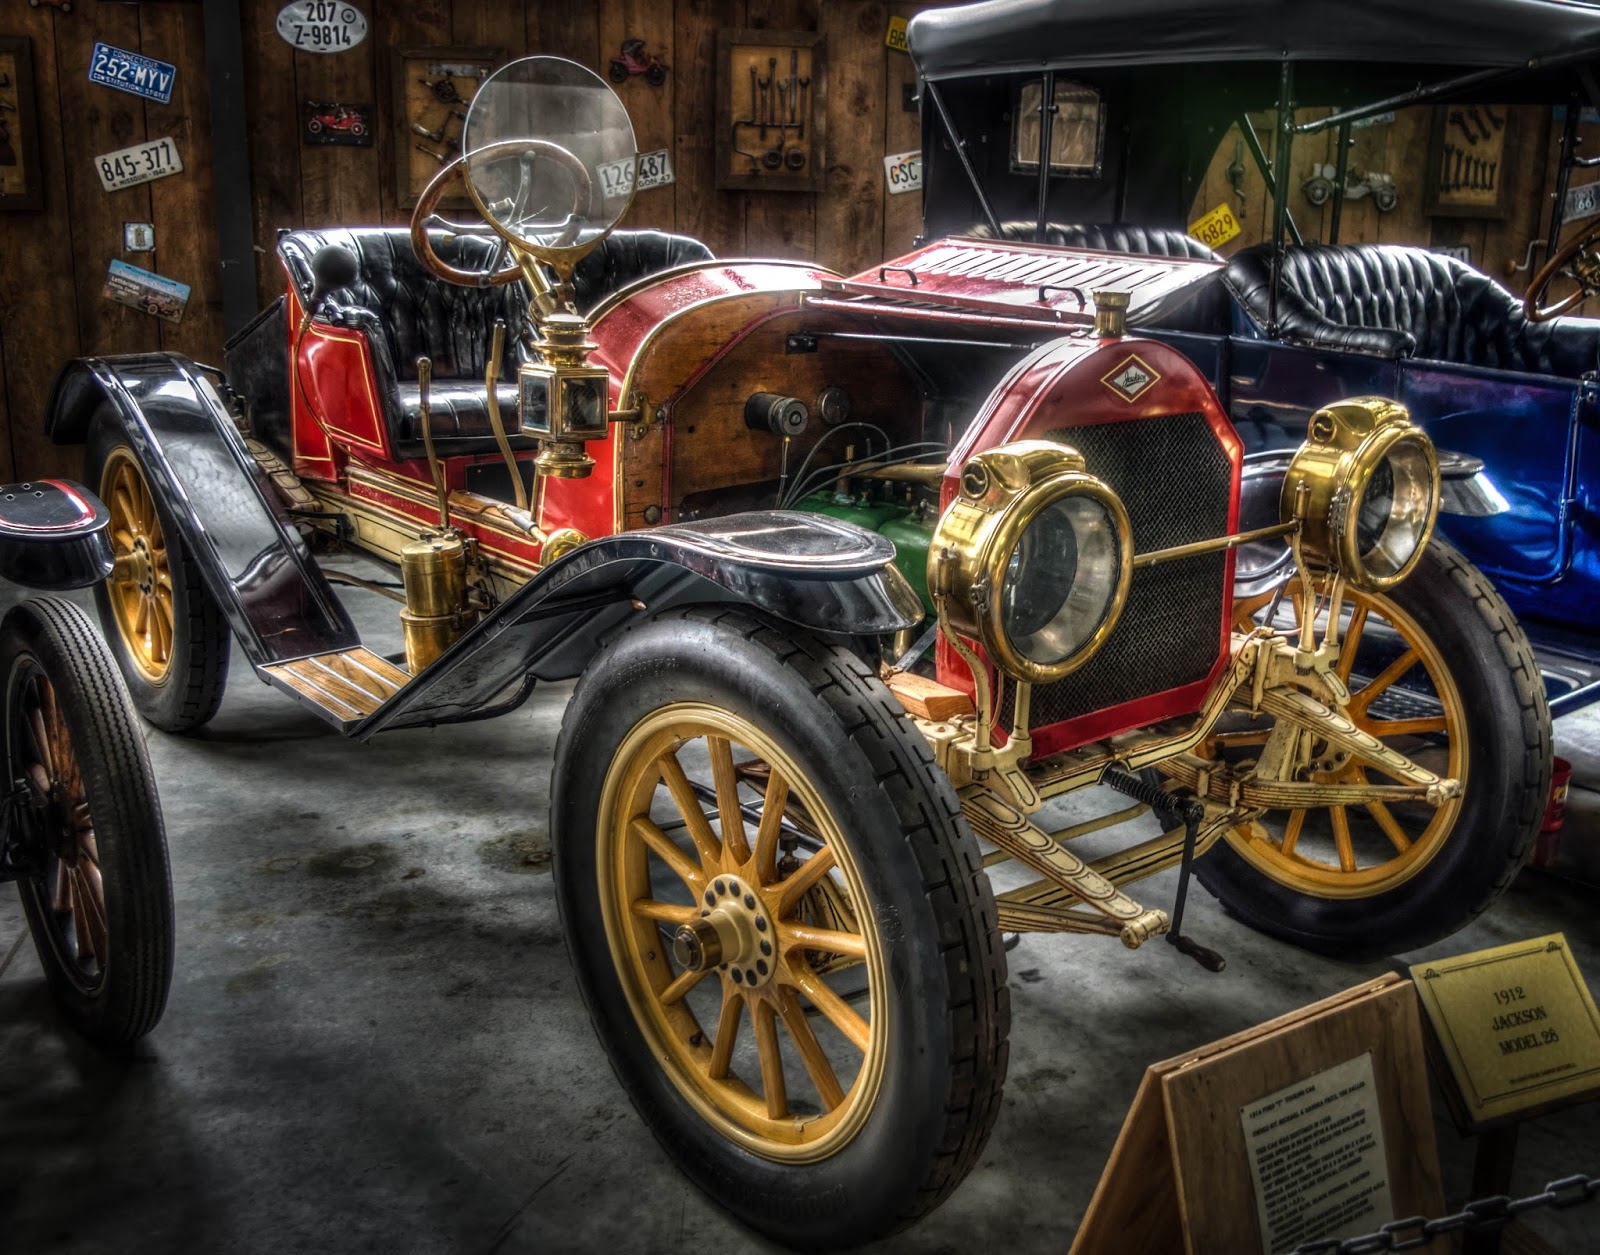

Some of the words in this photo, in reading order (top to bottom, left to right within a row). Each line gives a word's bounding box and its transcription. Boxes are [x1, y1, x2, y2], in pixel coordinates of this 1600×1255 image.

[306, 2, 336, 22] 207
[294, 25, 351, 45] Z-9814
[890, 29, 908, 49] BR
[113, 50, 159, 68] CONNECTICUT
[145, 88, 166, 100] STATE
[101, 143, 171, 182] 845-377
[890, 161, 918, 184] GSC
[119, 173, 148, 185] MISSOURI
[1578, 197, 1592, 209] 66
[1493, 985, 1526, 1005] 1912
[1492, 1006, 1547, 1031] JACKSON
[1499, 1034, 1542, 1056] MODEL
